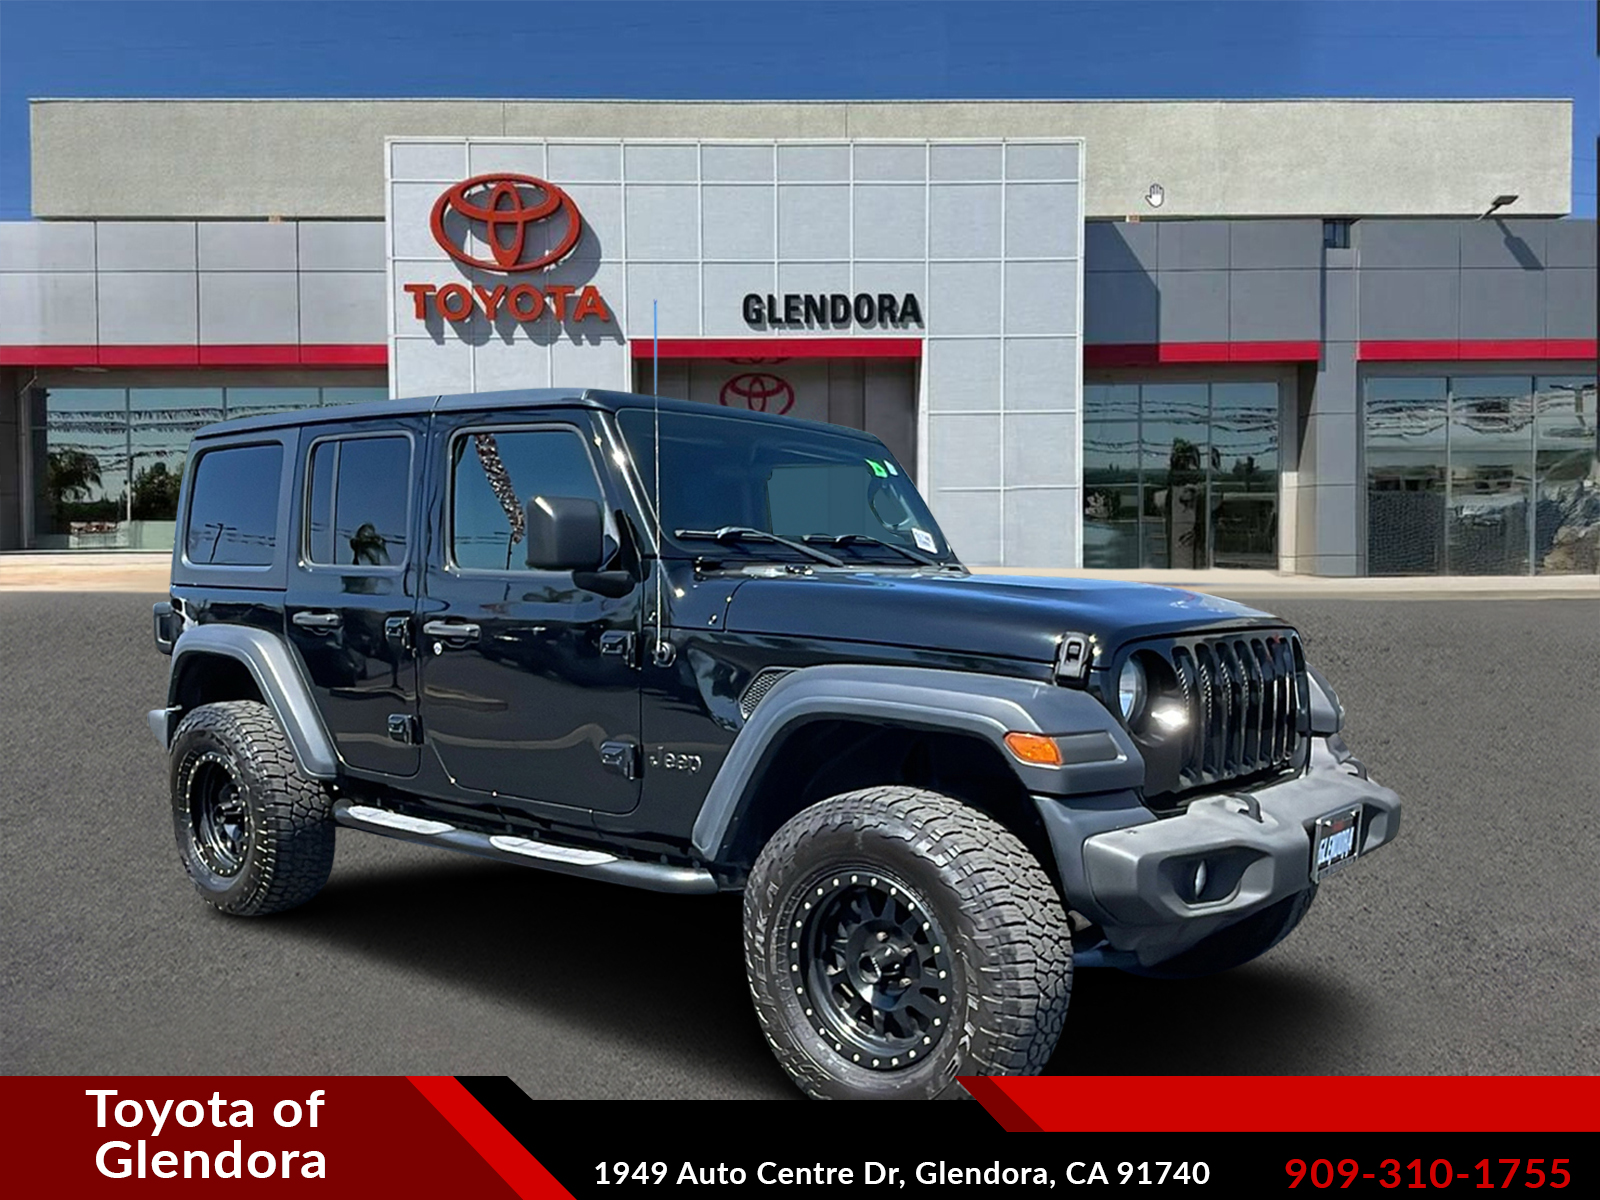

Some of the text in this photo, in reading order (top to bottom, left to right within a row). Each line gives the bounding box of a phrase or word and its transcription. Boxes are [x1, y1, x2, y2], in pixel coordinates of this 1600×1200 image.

[404, 283, 611, 323] TOYOTA
[742, 293, 923, 325] GLENDORA
[649, 746, 702, 776] Jeep
